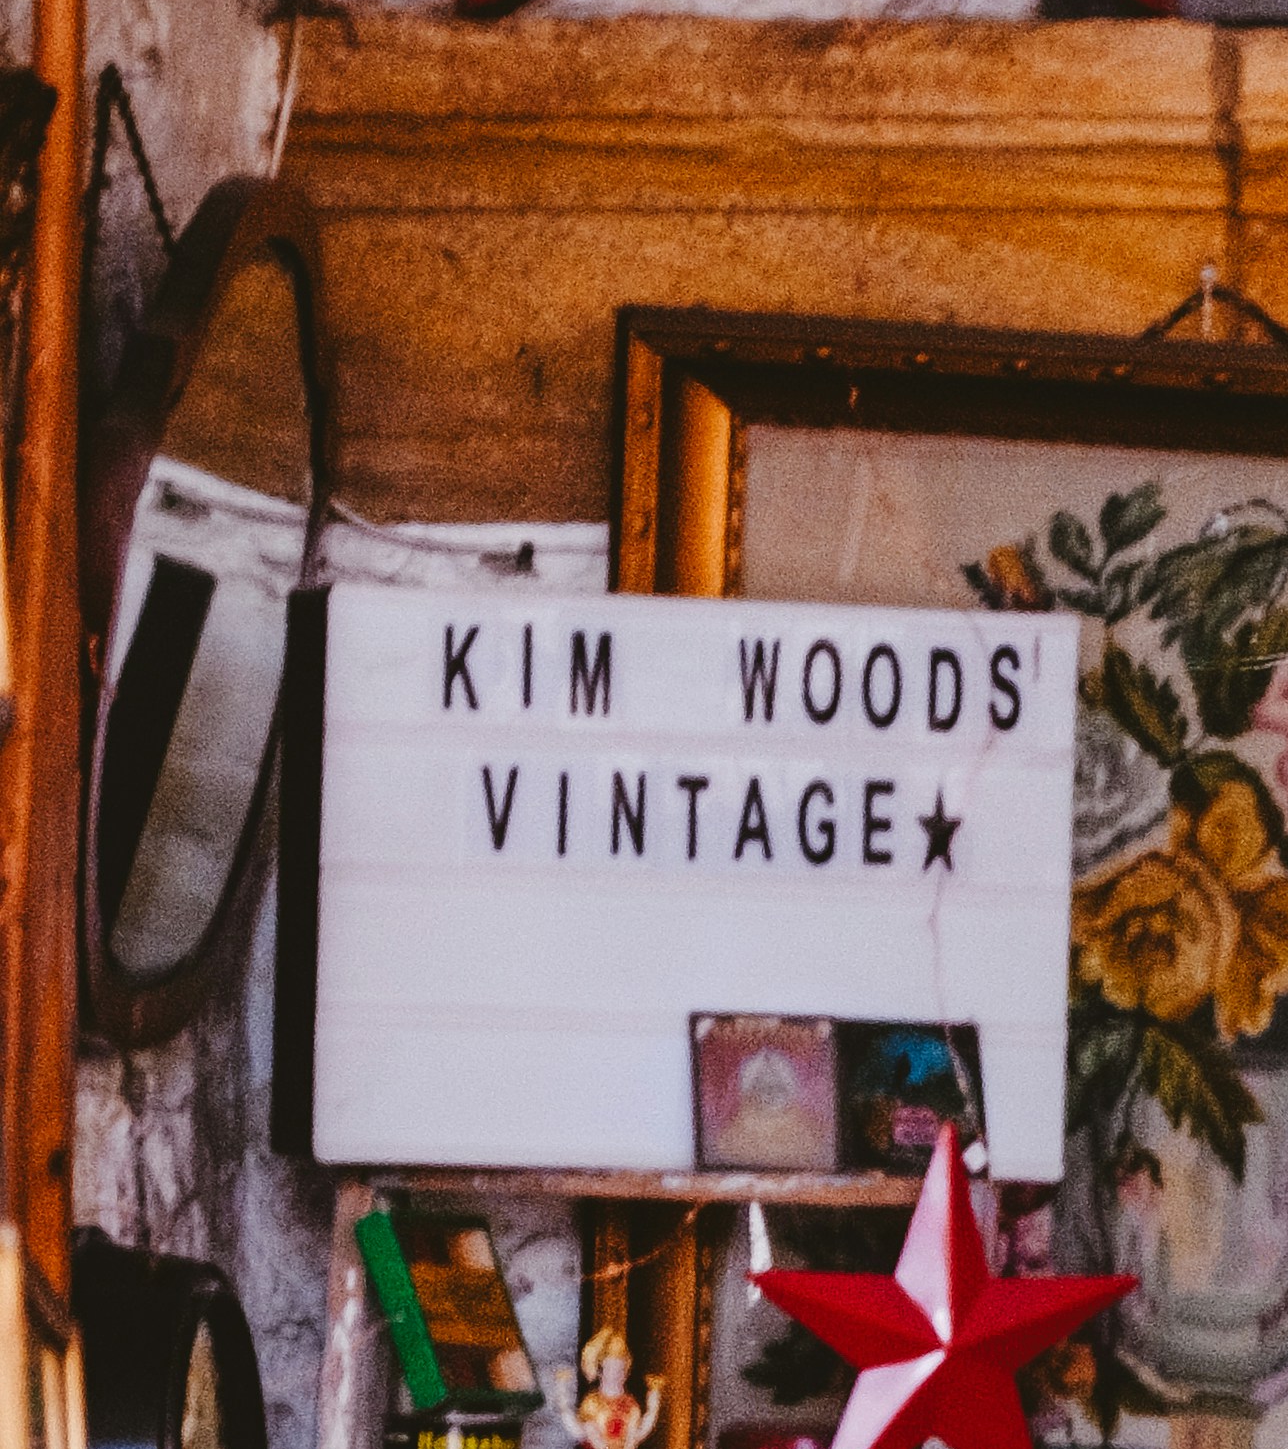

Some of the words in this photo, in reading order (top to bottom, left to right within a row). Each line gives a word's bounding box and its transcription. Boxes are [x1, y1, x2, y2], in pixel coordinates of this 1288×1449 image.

[442, 625, 614, 714] KIM
[738, 638, 1022, 733] WOODS
[481, 767, 896, 867] VINTAGE
